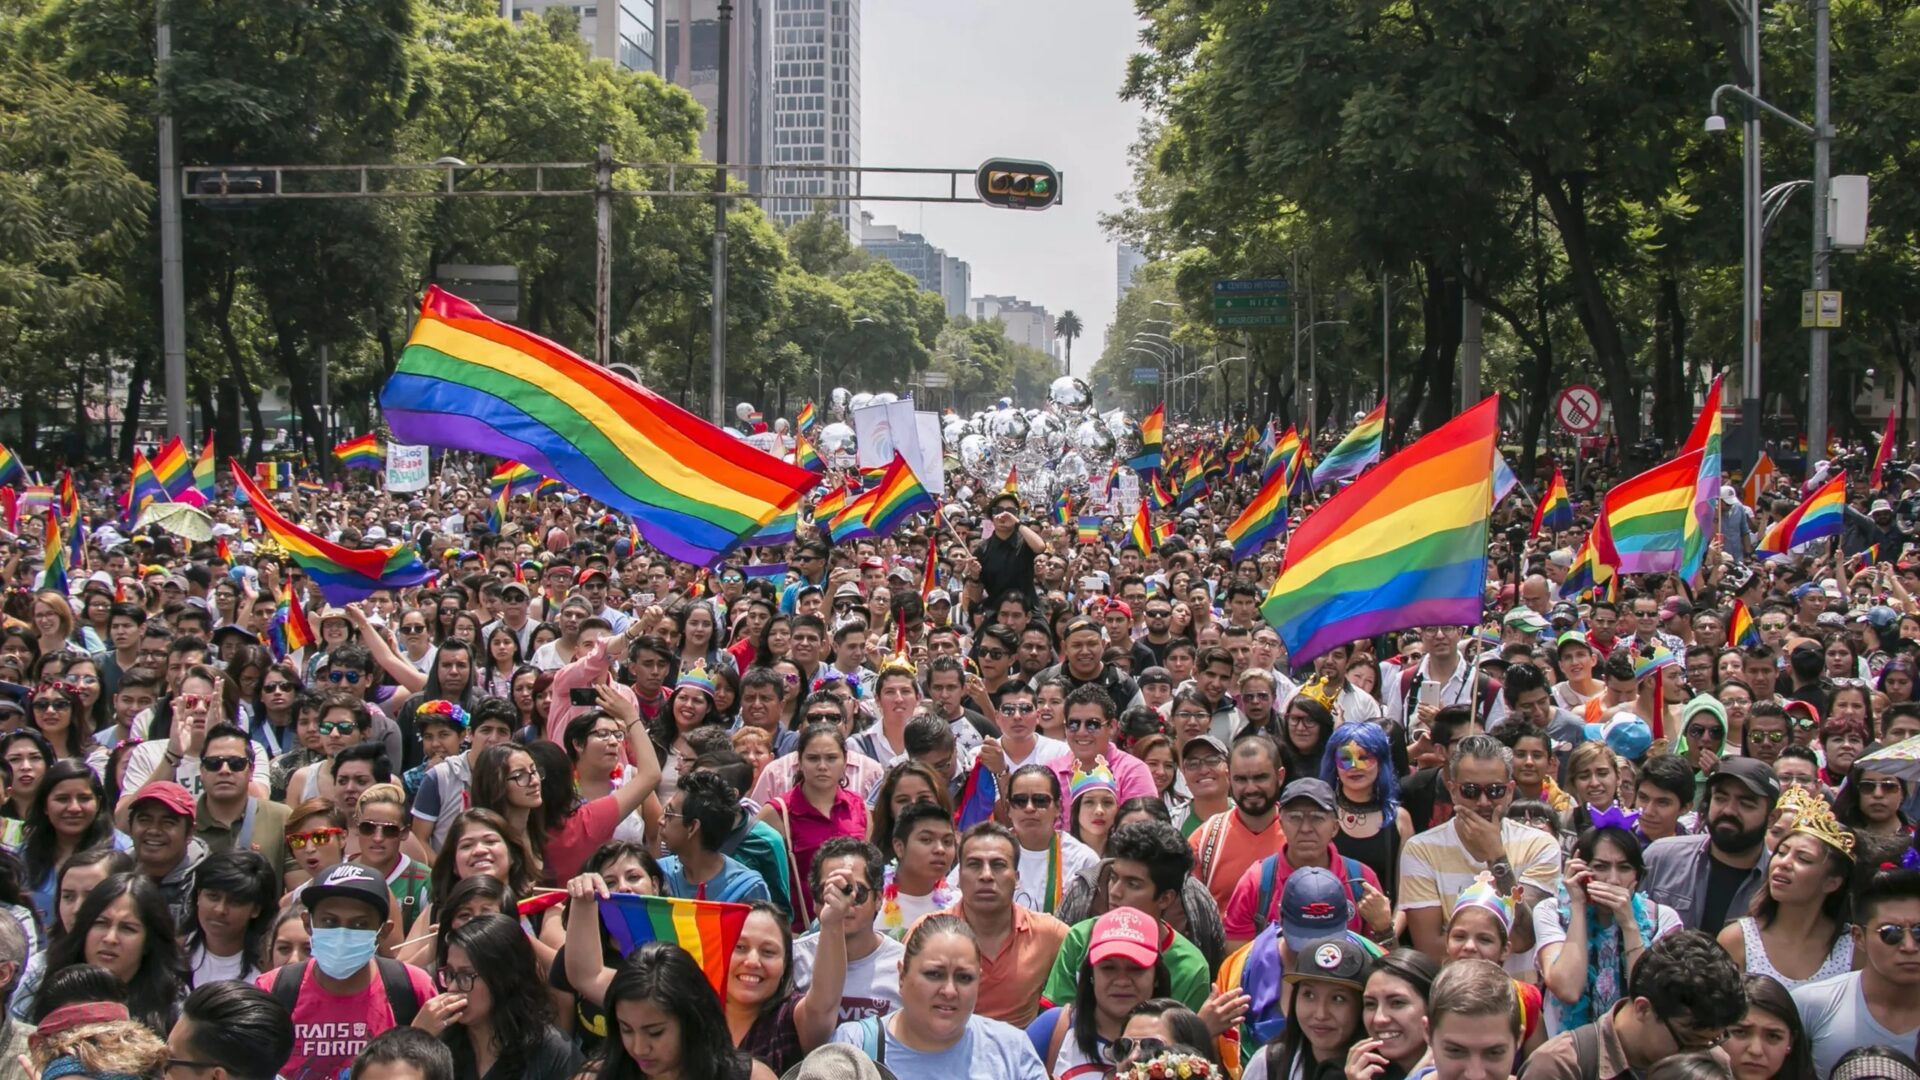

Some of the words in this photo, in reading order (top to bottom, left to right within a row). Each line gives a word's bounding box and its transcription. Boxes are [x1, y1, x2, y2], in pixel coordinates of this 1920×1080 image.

[1249, 298, 1279, 306] NIZA
[1228, 316, 1271, 324] INSURGENTES
[330, 865, 365, 879] NIKE
